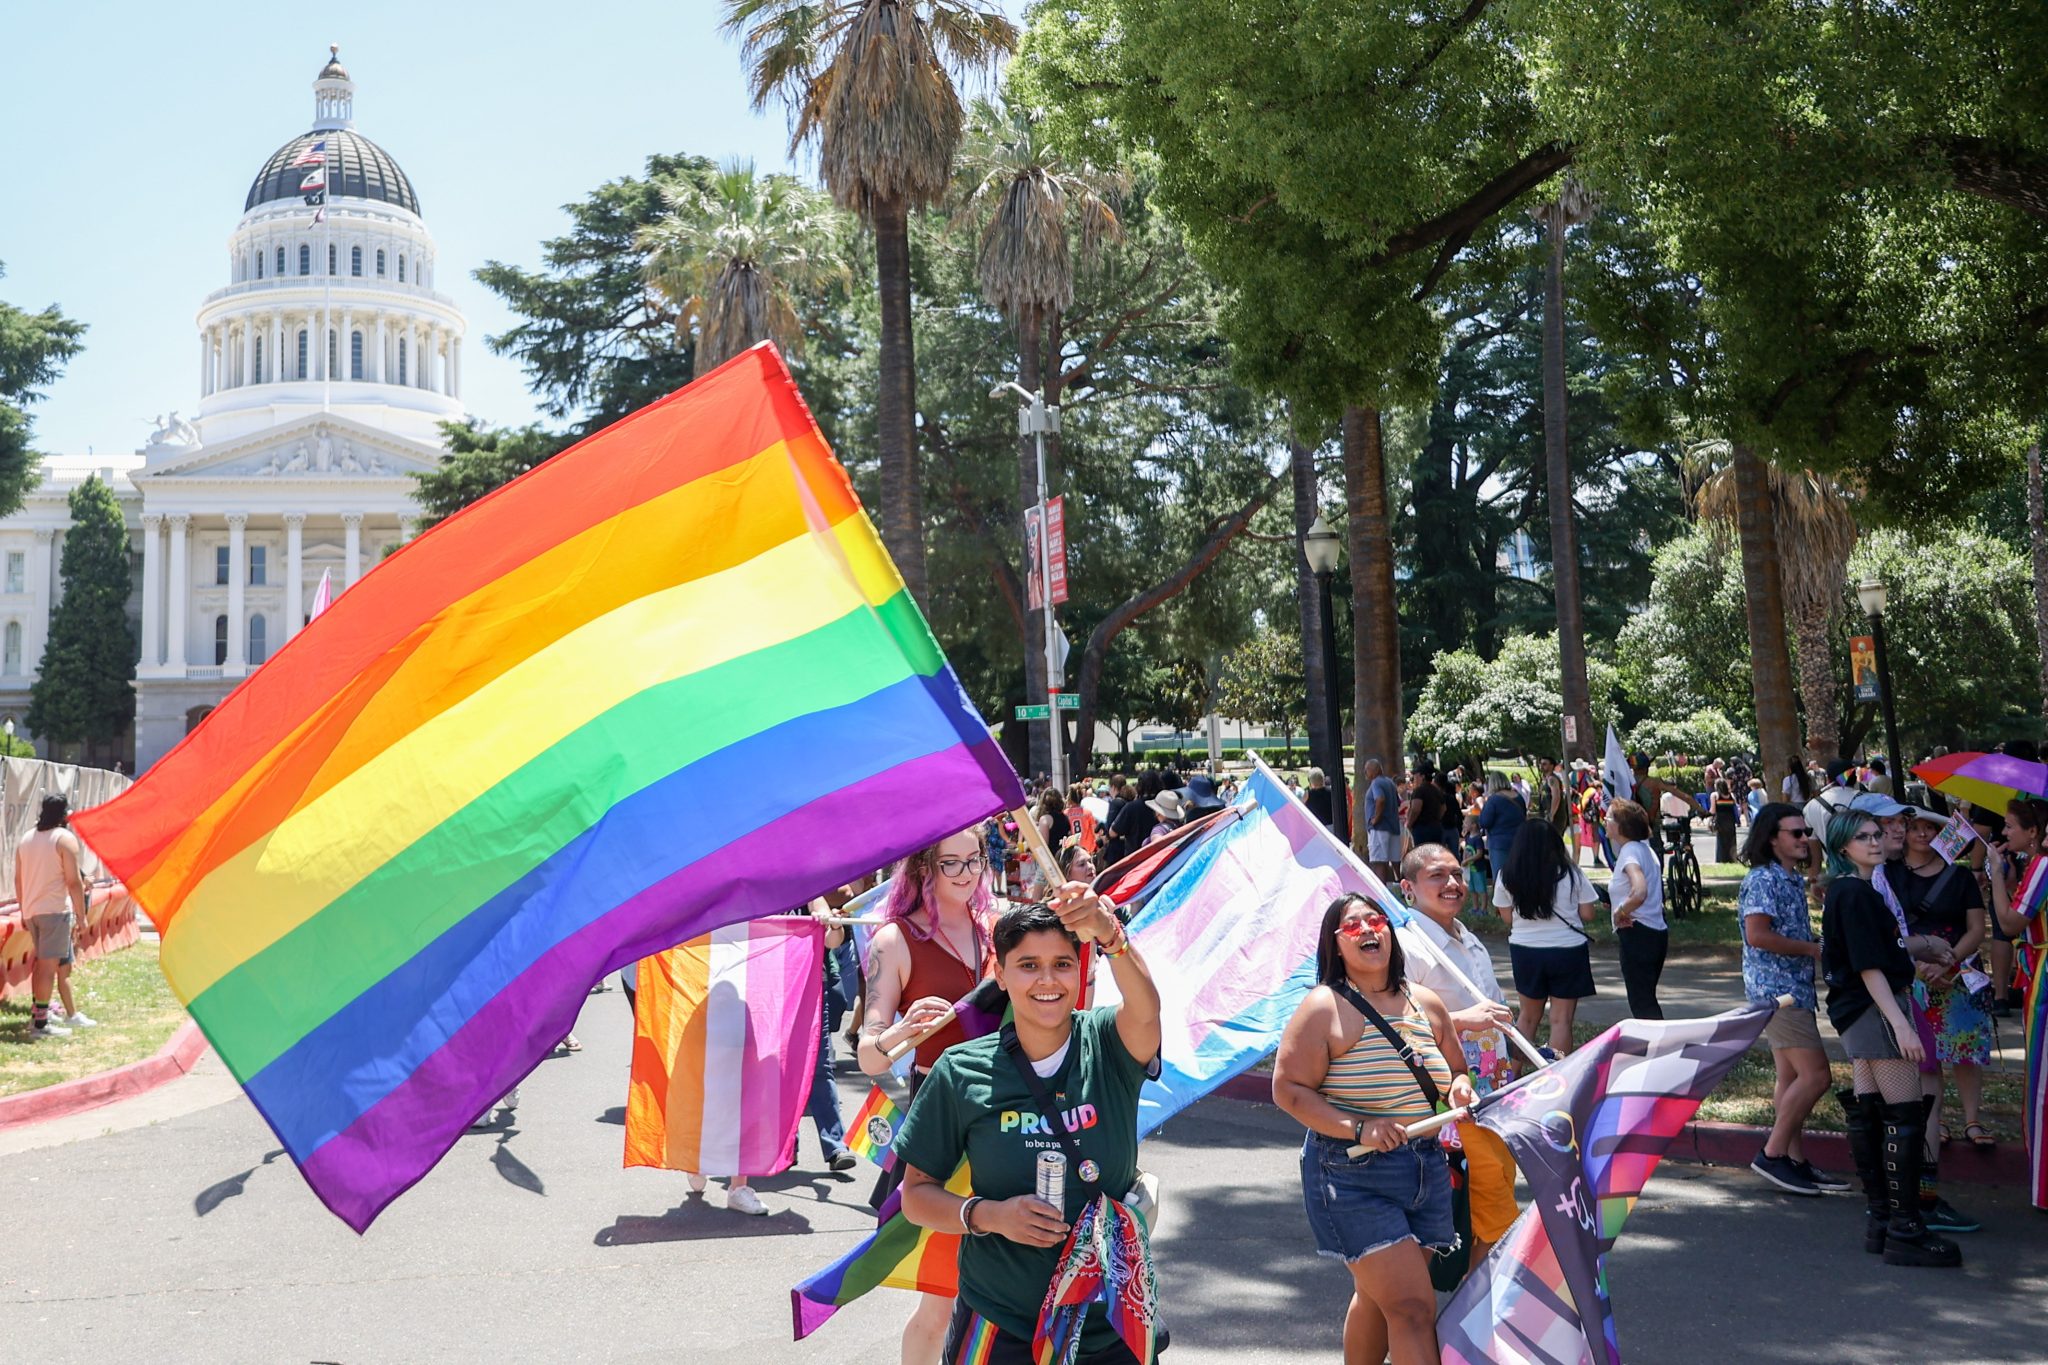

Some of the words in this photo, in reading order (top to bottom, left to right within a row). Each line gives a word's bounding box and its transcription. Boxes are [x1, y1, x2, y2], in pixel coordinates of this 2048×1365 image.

[1057, 695, 1073, 707] Capitol
[1017, 708, 1027, 718] 10
[1073, 819, 1082, 834] 8
[1025, 1139, 1034, 1148] to
[1034, 1138, 1045, 1148] be
[1045, 1140, 1051, 1148] a
